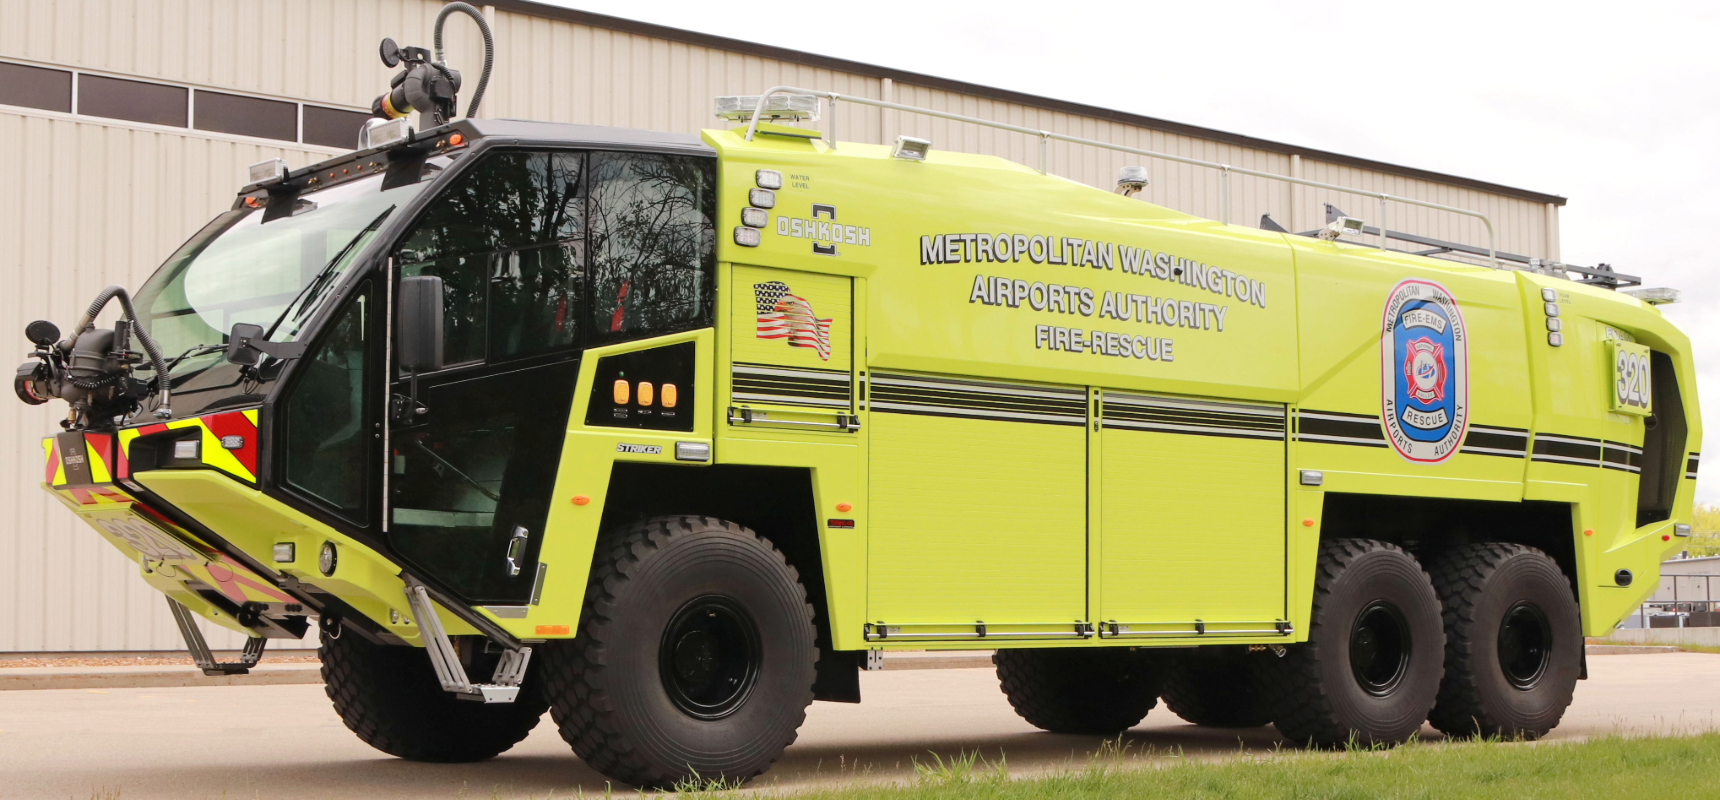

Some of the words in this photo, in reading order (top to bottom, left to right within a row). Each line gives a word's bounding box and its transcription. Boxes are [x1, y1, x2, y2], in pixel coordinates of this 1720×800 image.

[777, 216, 870, 246] OSHKOSH
[920, 233, 1114, 269] METROPOLITAN
[1118, 245, 1266, 308] WASHINGTON
[969, 274, 1095, 316] AIRPORTS
[1099, 291, 1228, 331] AUTHORITY
[1386, 285, 1420, 333] METROPOLITAN
[1431, 288, 1462, 342] WASHINGTON
[1404, 312, 1443, 329] FIRE-EMS
[1035, 324, 1174, 361] FIRE-RESCUE
[1616, 349, 1651, 409] 320
[1386, 398, 1413, 454] AIRPORTS
[1434, 404, 1464, 457] AUTHORITY
[1406, 410, 1444, 427] RESCUE
[616, 442, 662, 454] STRIKER
